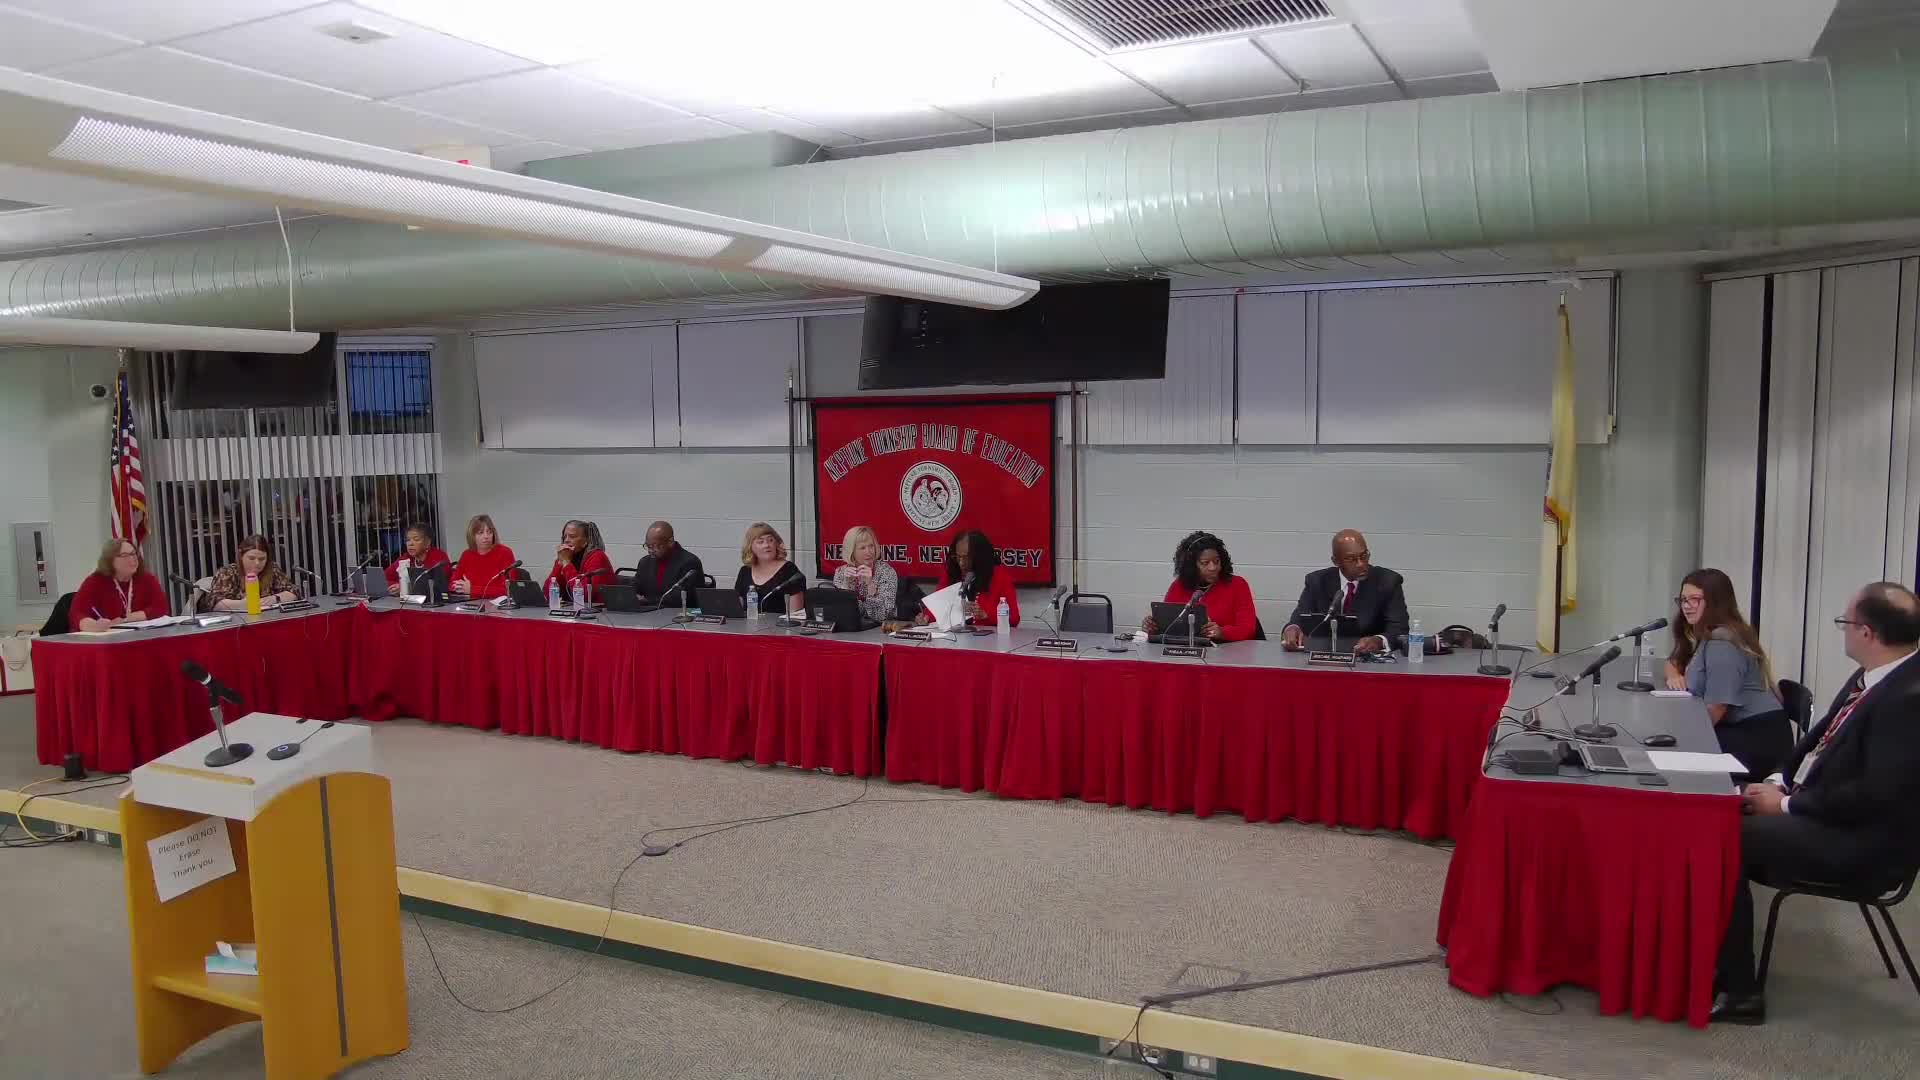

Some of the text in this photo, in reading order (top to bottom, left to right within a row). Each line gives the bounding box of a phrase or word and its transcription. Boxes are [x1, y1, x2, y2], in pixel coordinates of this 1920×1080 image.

[866, 423, 918, 457] TOWNSHIP
[921, 422, 958, 452] BOARD
[962, 427, 979, 455] OF
[980, 432, 1045, 489] EDUCATION
[823, 543, 912, 564] NENE,
[918, 545, 950, 564] NE
[158, 825, 217, 855] Please DO NOT
[179, 848, 201, 861] Erase
[173, 858, 214, 879] Thank you
